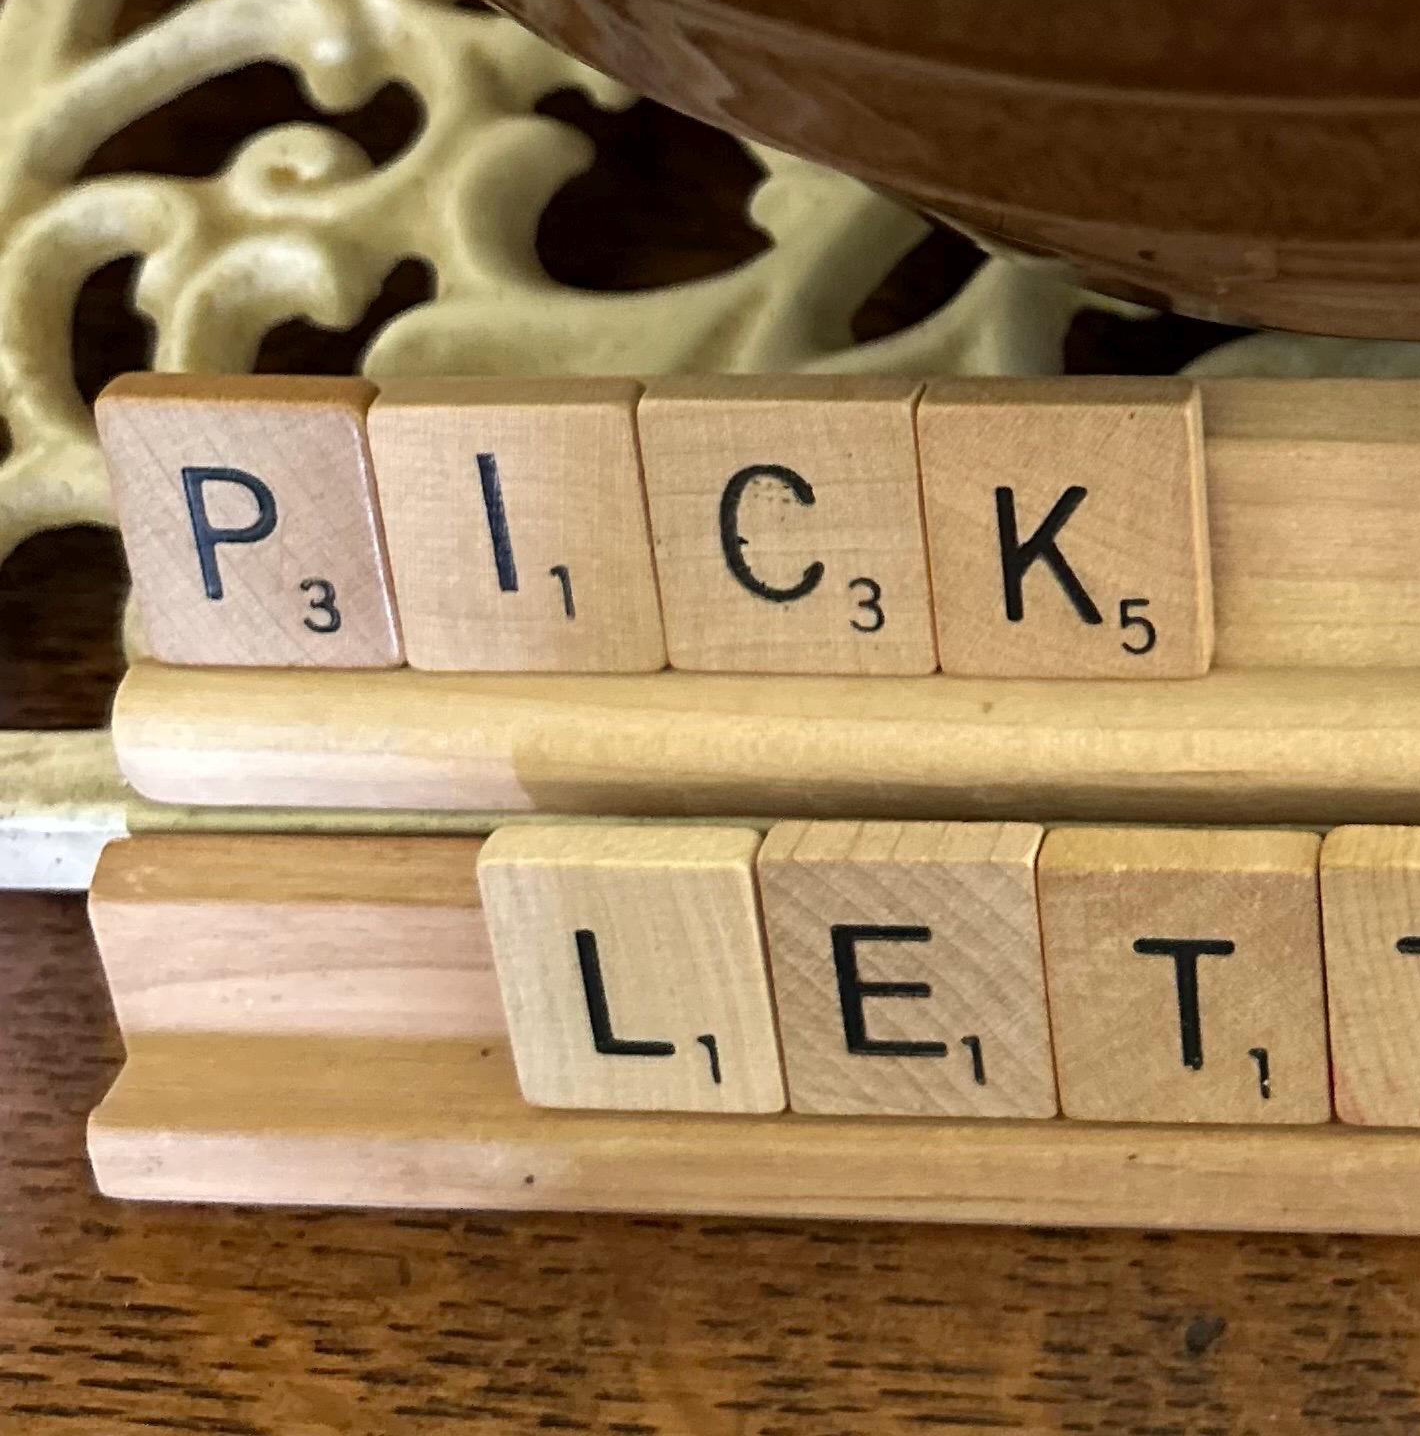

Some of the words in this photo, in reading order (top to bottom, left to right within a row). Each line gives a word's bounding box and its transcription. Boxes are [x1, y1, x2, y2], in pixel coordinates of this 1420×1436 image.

[300, 579, 341, 634] 3
[550, 565, 575, 619] 1
[849, 577, 885, 633] 3
[1120, 598, 1156, 655] 5
[697, 1034, 721, 1084] 1
[961, 1036, 986, 1085] 1
[1248, 1048, 1270, 1099] 1
